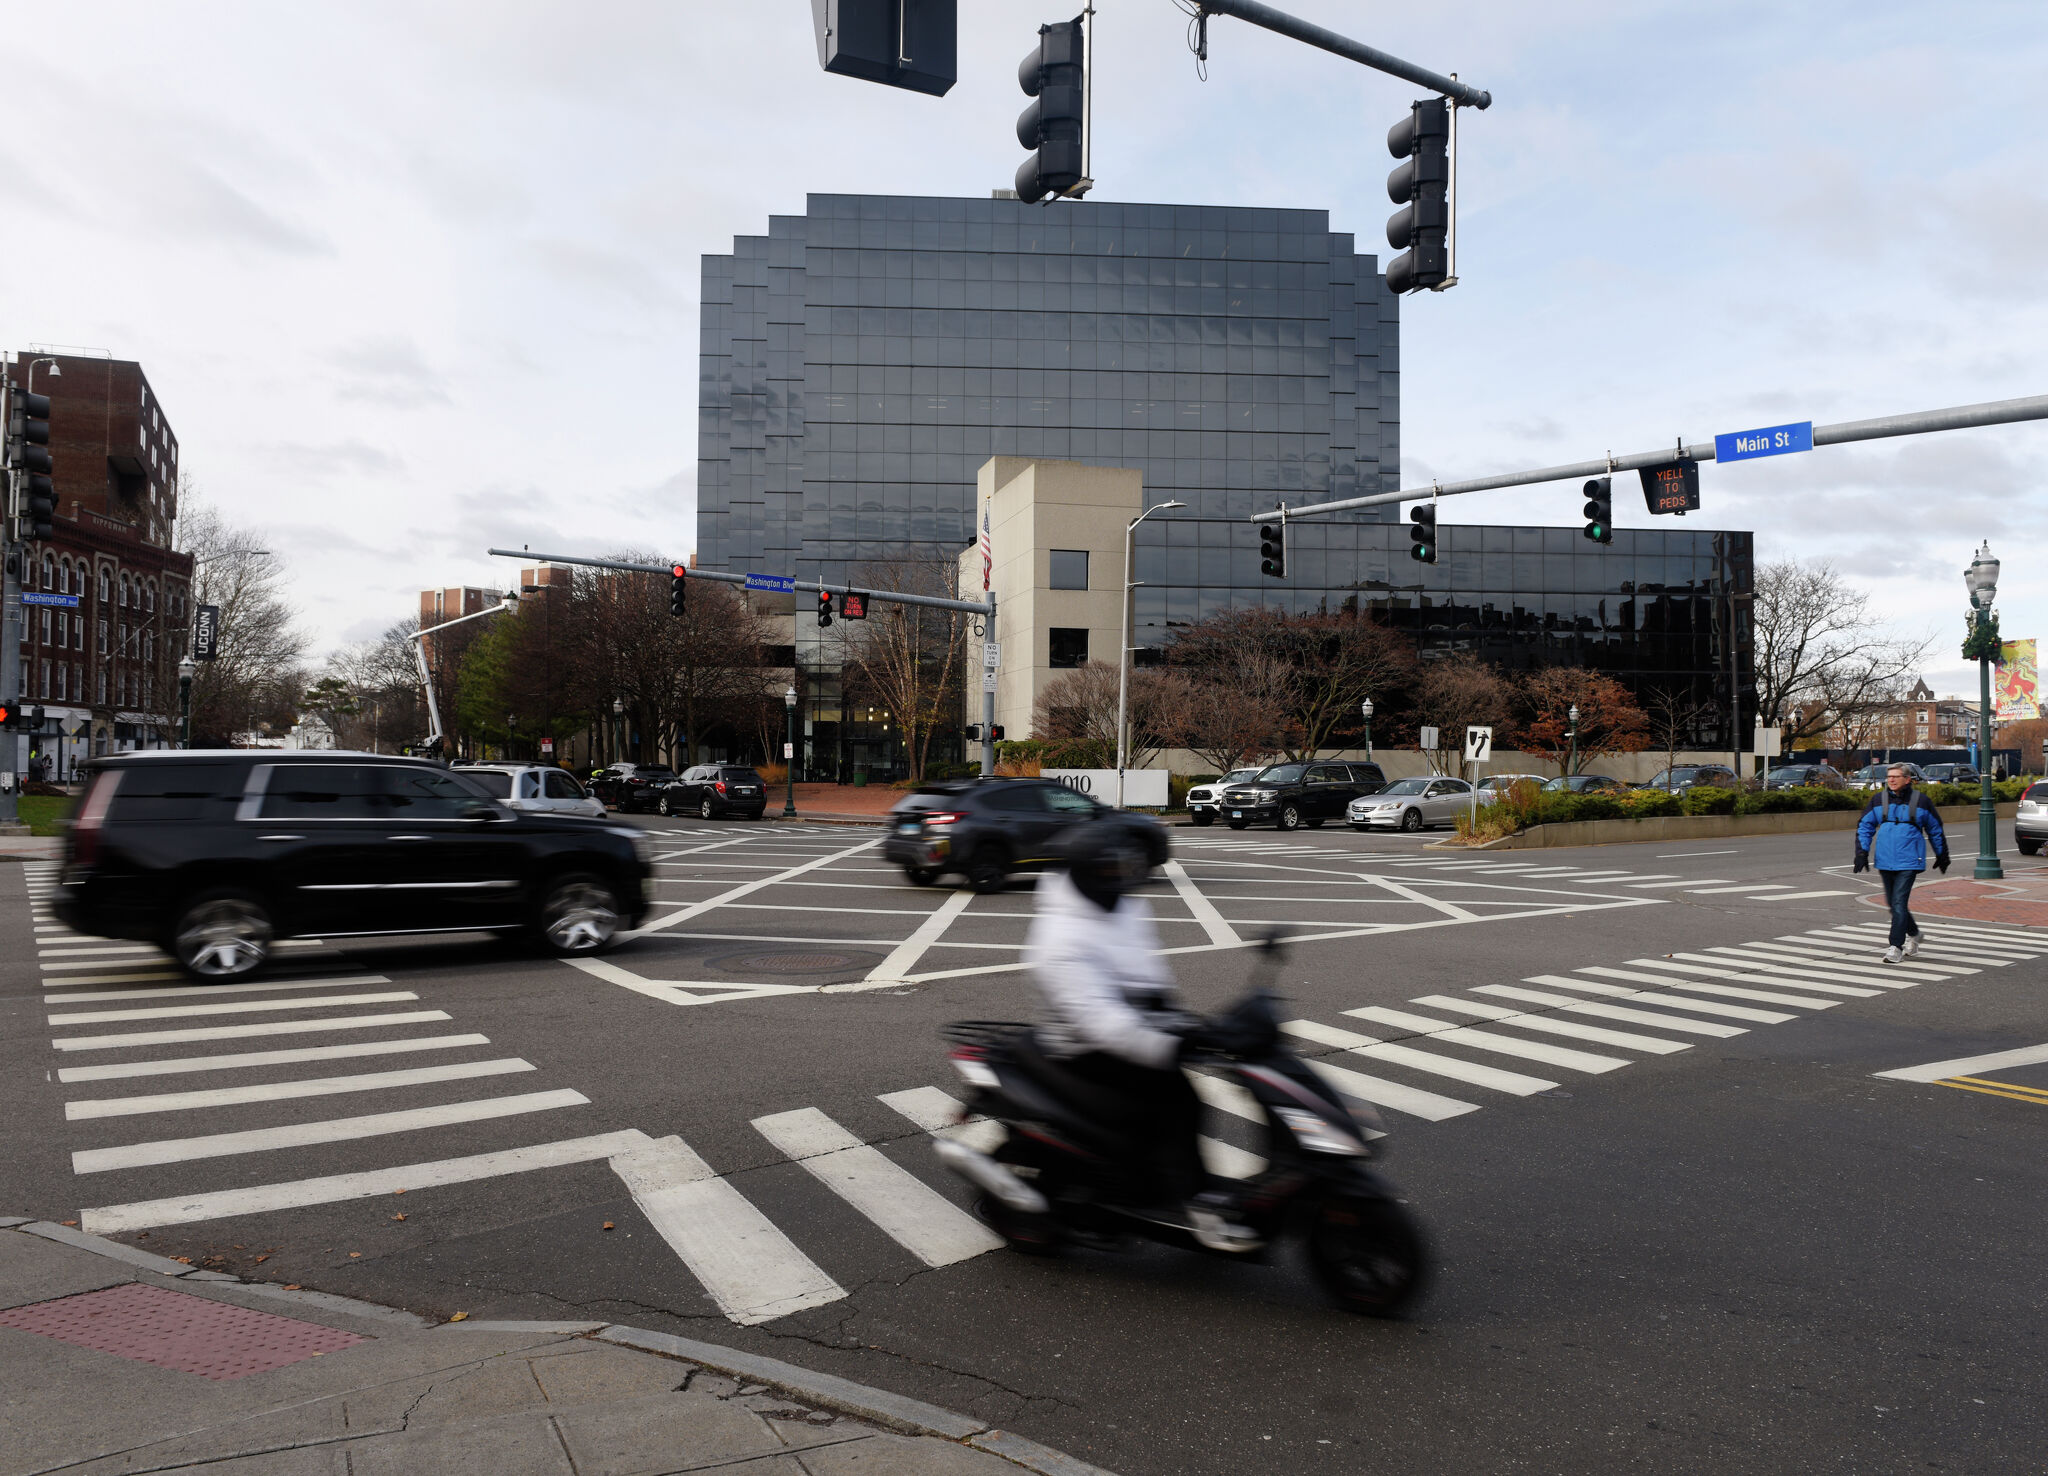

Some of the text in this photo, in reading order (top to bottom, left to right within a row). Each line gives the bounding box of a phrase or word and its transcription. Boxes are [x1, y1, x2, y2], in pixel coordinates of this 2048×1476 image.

[1736, 432, 1789, 453] Main St
[1665, 482, 1679, 494] TO
[1659, 496, 1686, 509] PEDS
[746, 577, 780, 589] Washington
[23, 594, 67, 605] Washington
[848, 596, 860, 604] NO
[198, 612, 210, 653] UCONN
[1055, 775, 1091, 793] 1010
